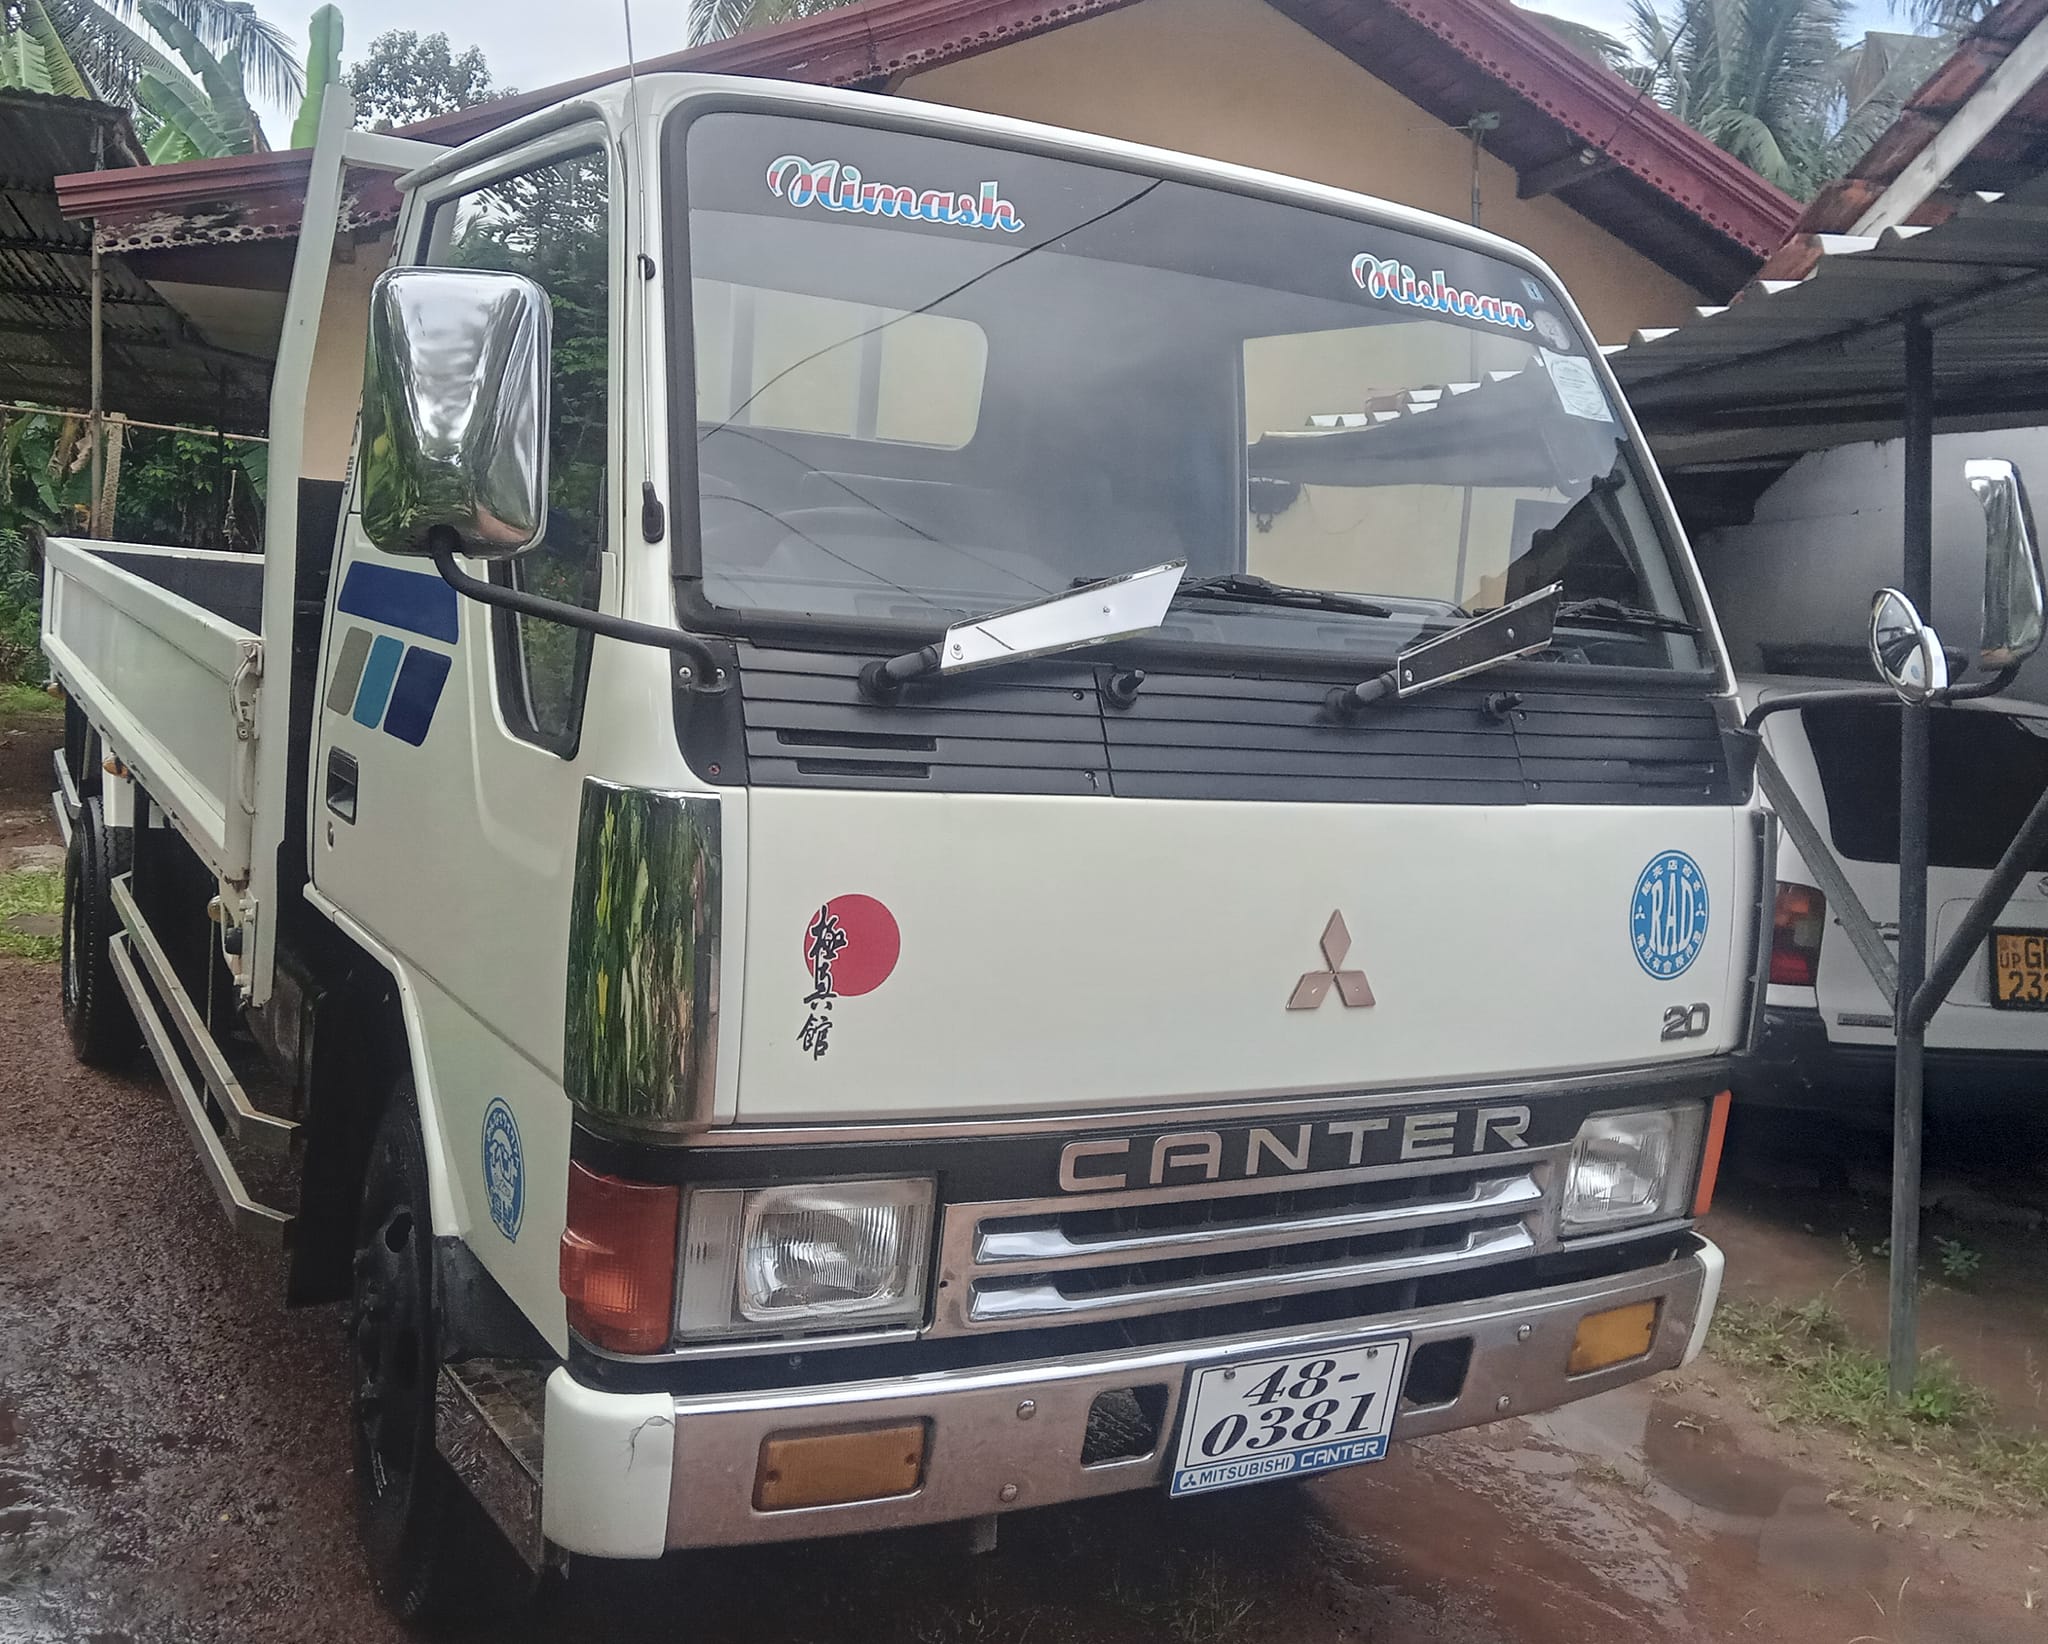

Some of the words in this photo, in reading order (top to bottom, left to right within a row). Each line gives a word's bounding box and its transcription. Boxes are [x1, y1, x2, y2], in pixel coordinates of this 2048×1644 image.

[1649, 872, 1695, 957] RAD
[2000, 953, 2021, 968] UP
[2024, 938, 2048, 968] G
[1660, 1002, 1710, 1042] 20
[1060, 1105, 1531, 1192] CANTER
[1242, 1360, 1360, 1407] 48-
[1201, 1392, 1377, 1457] 0381
[1200, 1454, 1292, 1485] MITSUBISHI
[1300, 1440, 1379, 1468] CANTER
